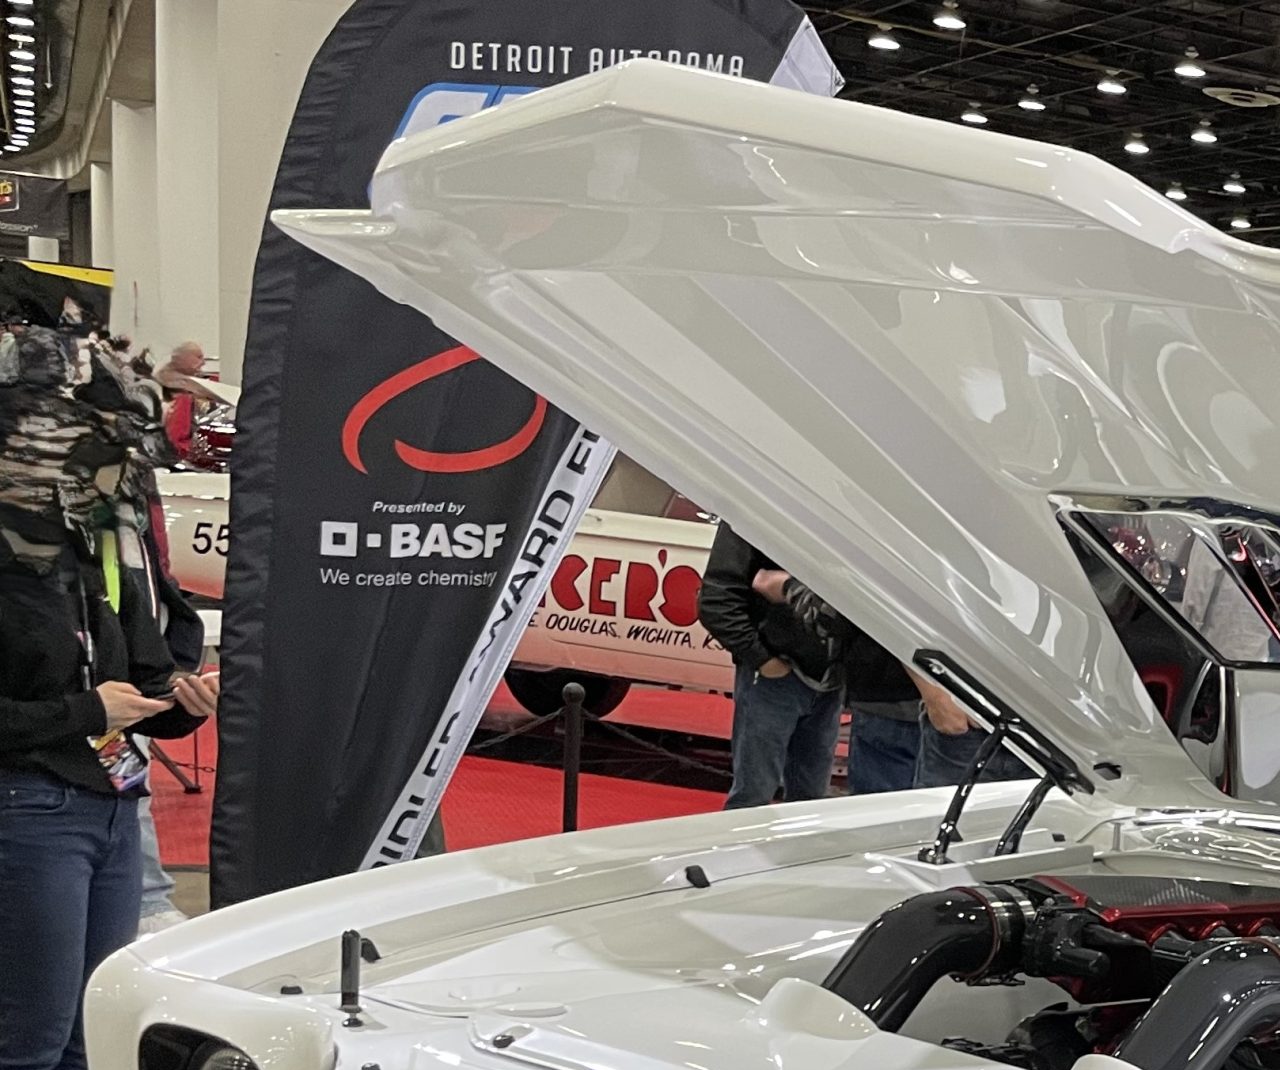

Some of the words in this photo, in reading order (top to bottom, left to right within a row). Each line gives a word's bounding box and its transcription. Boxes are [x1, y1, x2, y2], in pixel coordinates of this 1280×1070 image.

[450, 41, 573, 74] DETROIT
[372, 501, 445, 513] Presented
[447, 502, 466, 516] by
[390, 523, 507, 559] BASF
[320, 568, 350, 585] We
[355, 570, 413, 587] create
[418, 570, 497, 588] chemistry
